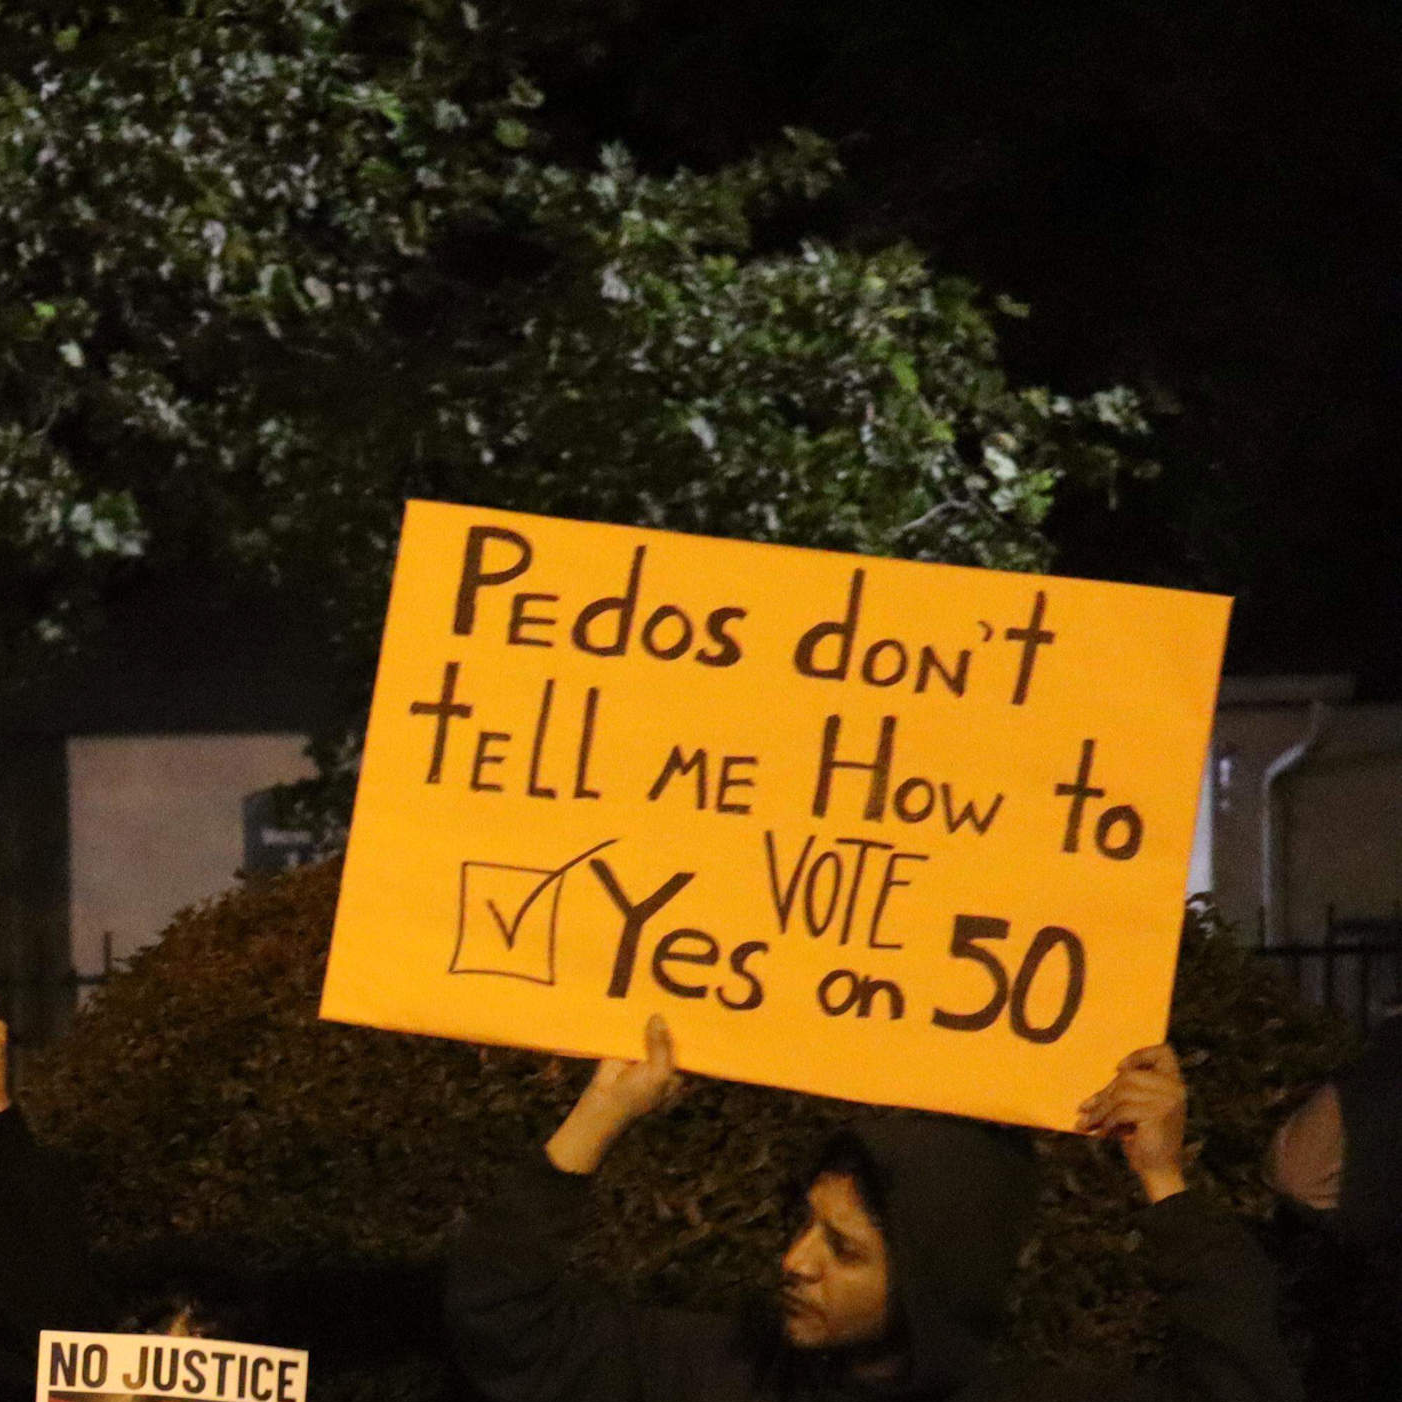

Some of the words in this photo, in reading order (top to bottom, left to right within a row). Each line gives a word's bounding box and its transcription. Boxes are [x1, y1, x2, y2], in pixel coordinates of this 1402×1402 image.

[647, 744, 759, 815] ME
[1054, 739, 1144, 861] to
[764, 830, 930, 950] VOTE
[590, 858, 769, 1011] Yes
[817, 969, 905, 1020] on
[931, 914, 1086, 1044] 50
[48, 1341, 108, 1389] NO
